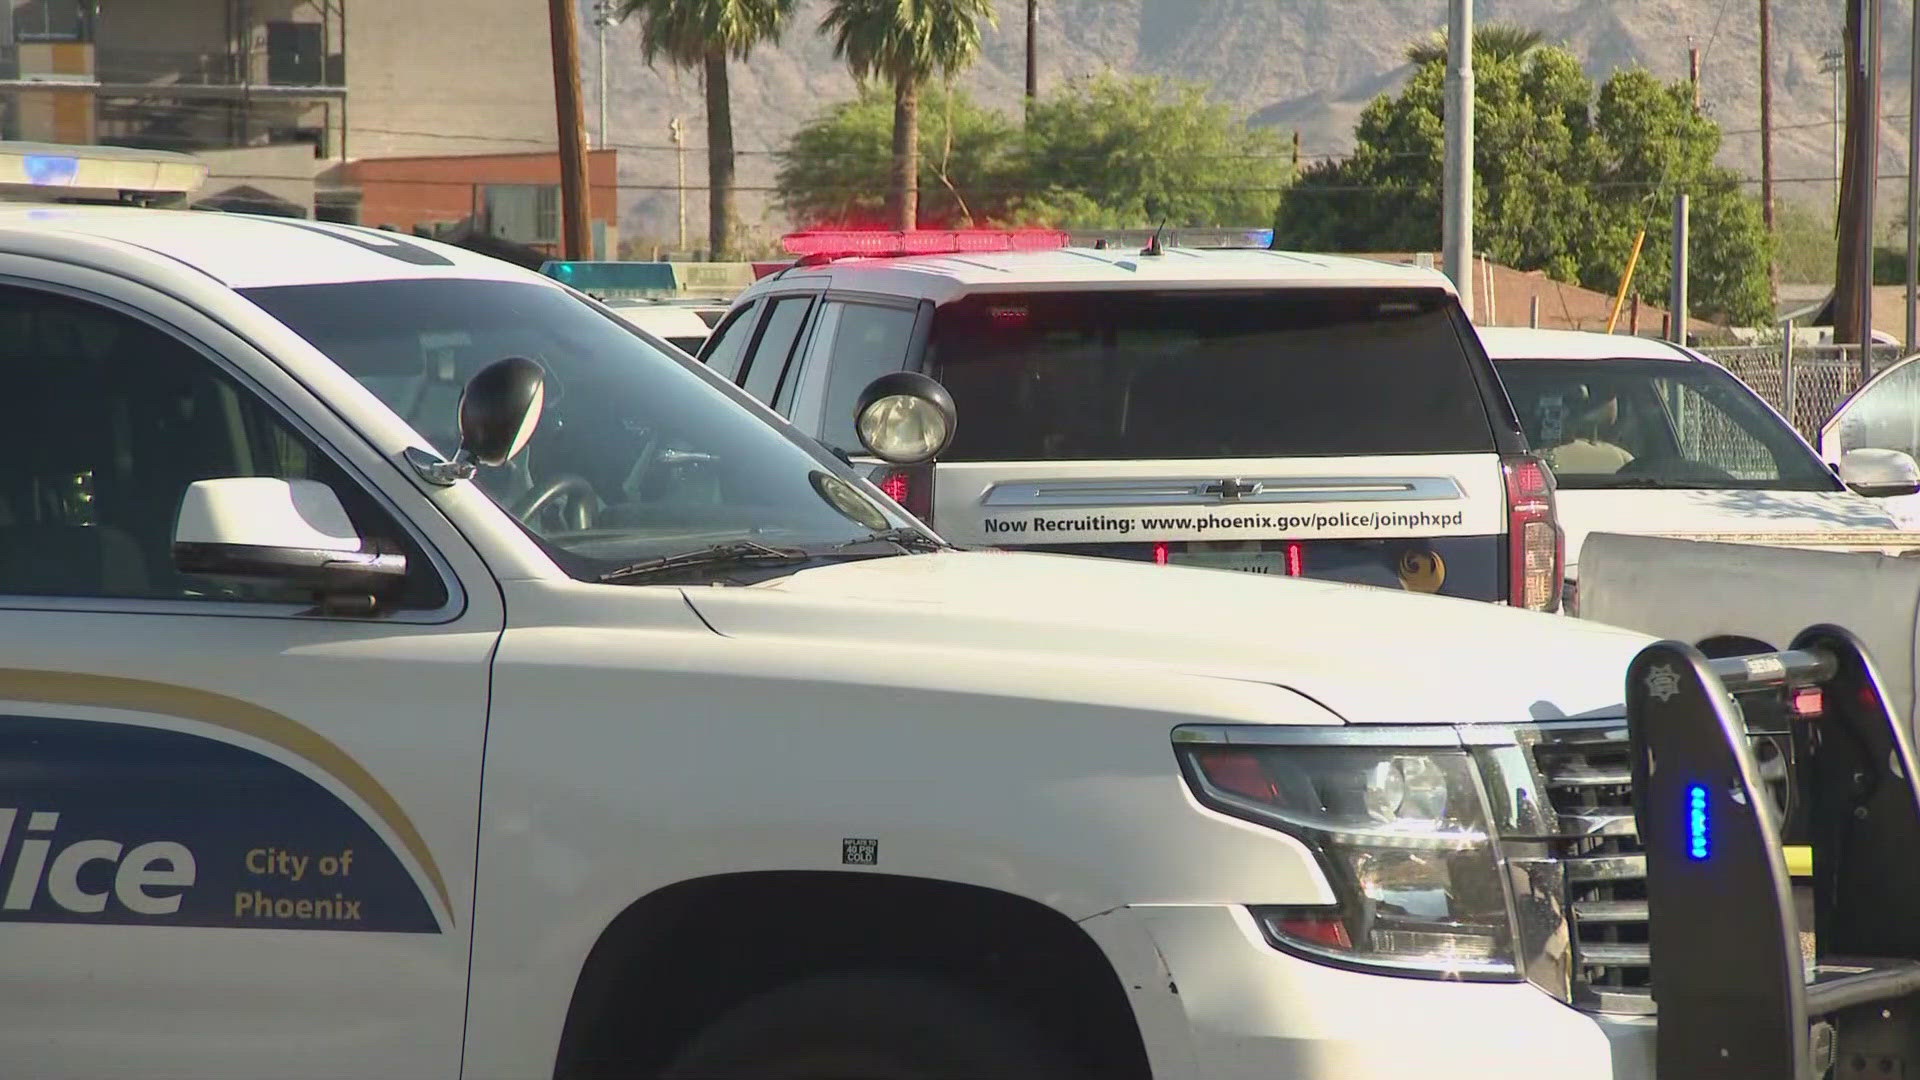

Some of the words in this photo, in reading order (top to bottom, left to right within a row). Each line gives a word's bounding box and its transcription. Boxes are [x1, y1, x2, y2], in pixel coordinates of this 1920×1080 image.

[984, 518, 1027, 533] Now
[1034, 516, 1135, 534] Recruiting:
[1141, 511, 1462, 532] www.phoenix.gov/police/joinphxpd
[0, 808, 196, 914] ice
[245, 847, 309, 881] City
[319, 848, 353, 876] of
[847, 853, 873, 862] COLD
[234, 890, 361, 919] Phoenix
